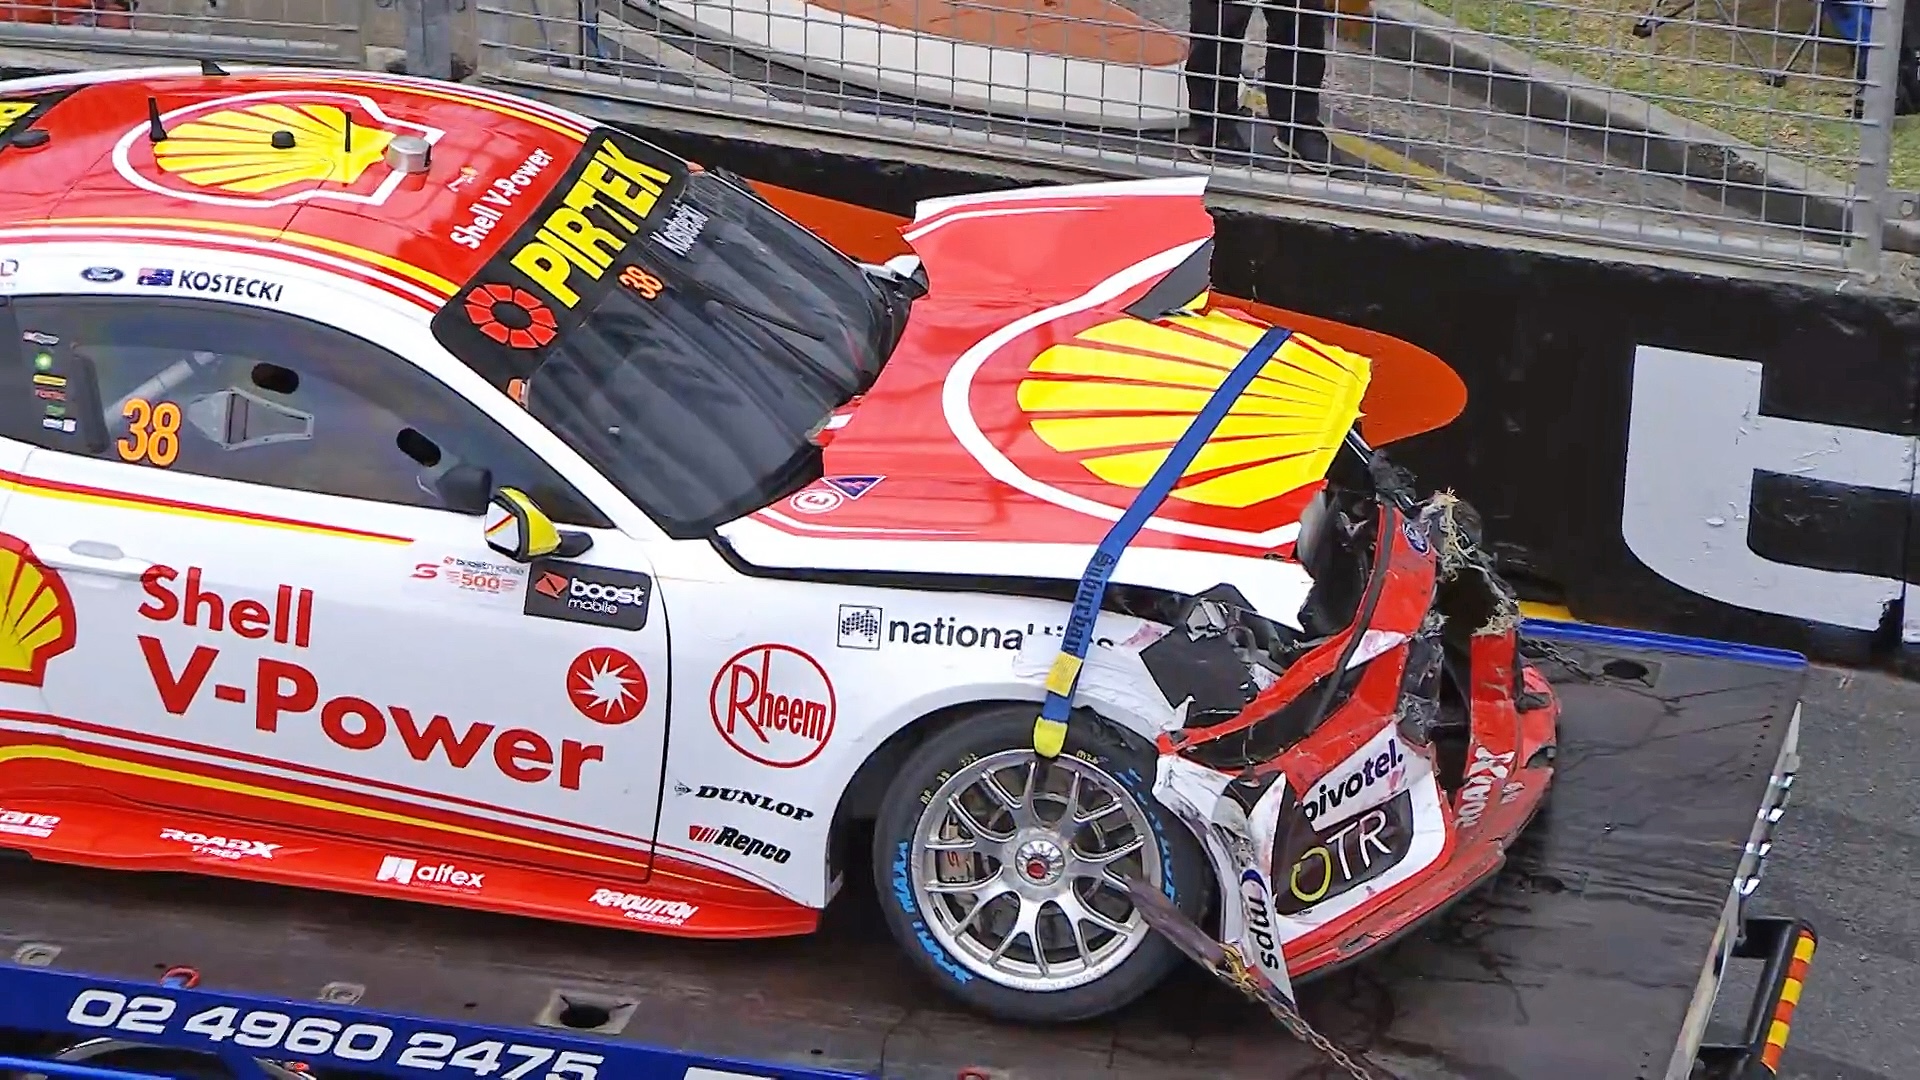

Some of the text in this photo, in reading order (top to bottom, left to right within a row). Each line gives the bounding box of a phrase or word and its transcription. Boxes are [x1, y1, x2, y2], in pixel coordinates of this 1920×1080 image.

[450, 148, 553, 250] Shell V-Power
[509, 138, 672, 309] PIRTEK
[178, 269, 284, 302] KOSTECKI
[617, 263, 665, 300] 38
[116, 398, 182, 468] 38
[137, 564, 314, 648] Shell
[462, 573, 500, 590] 500
[568, 598, 618, 615] mobile
[570, 577, 645, 606] boost
[137, 634, 604, 791] V-Power
[726, 650, 826, 743] Rheem
[695, 785, 815, 822] DUNLOP
[160, 828, 284, 859] ROADX
[714, 825, 792, 864] Repco
[1290, 808, 1392, 903] OTR
[588, 888, 700, 920] REVOLUTION
[1247, 895, 1280, 971] mps
[66, 989, 604, 1080] 02 4960 2475
